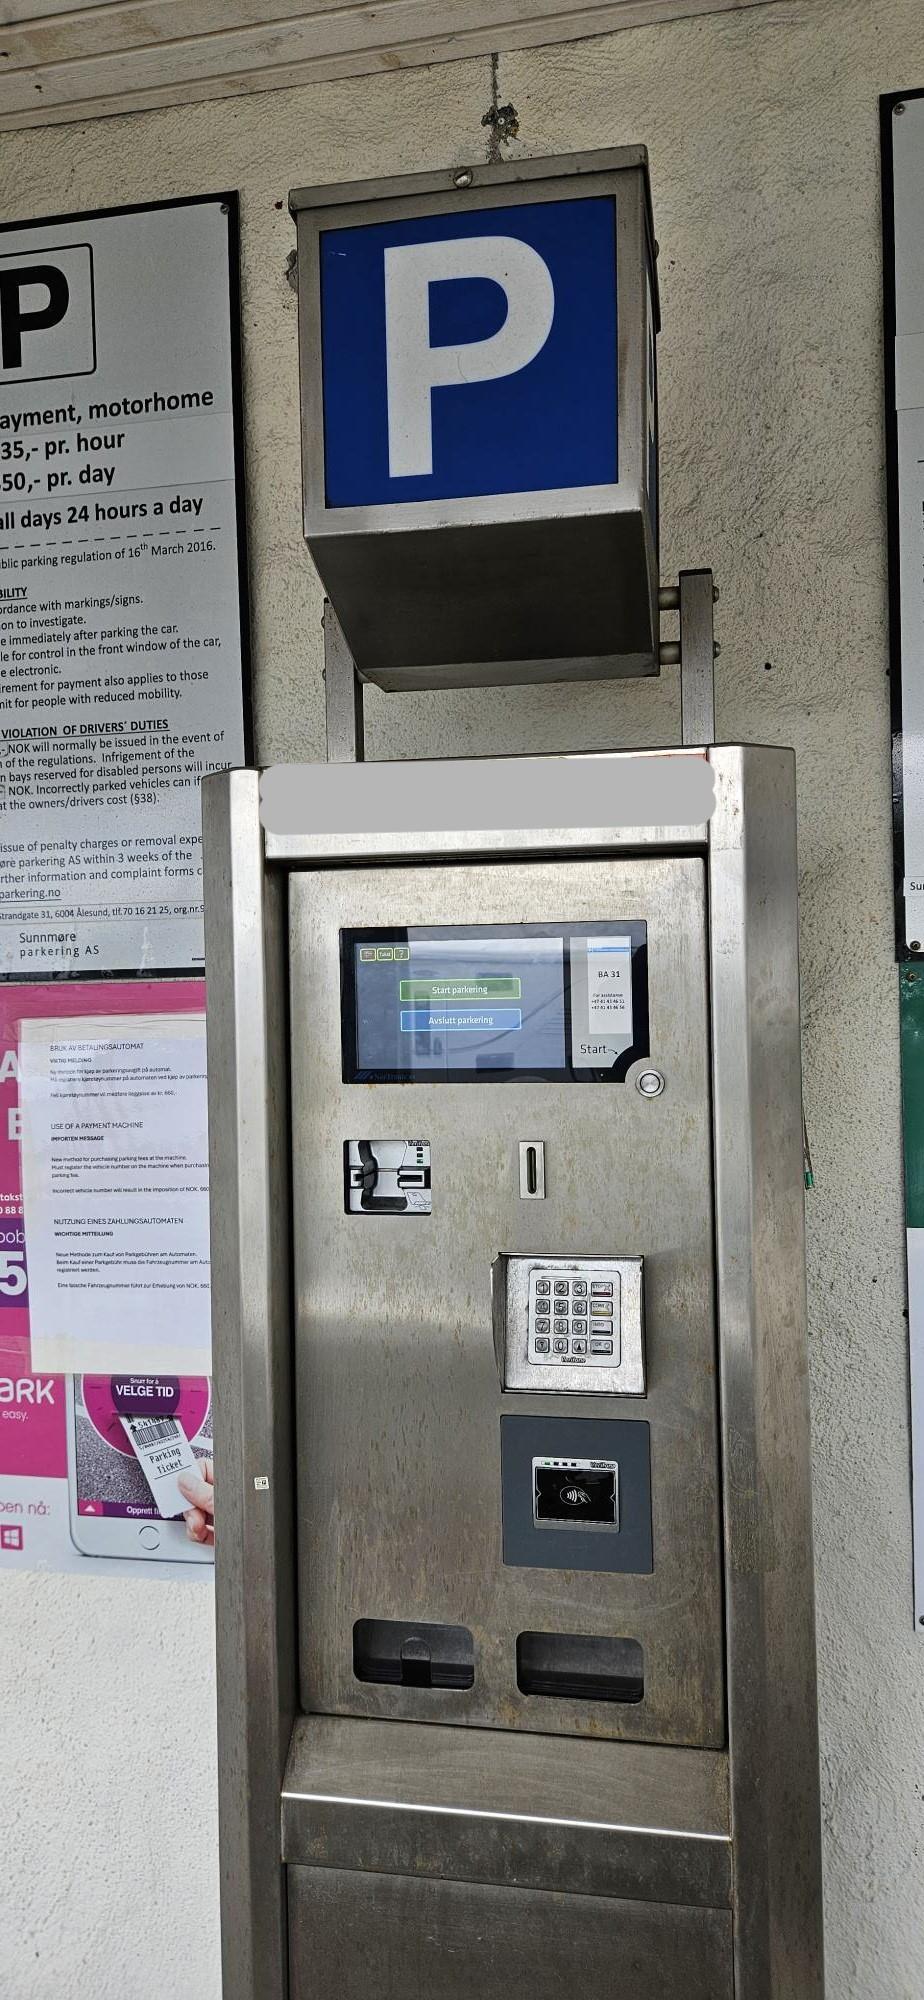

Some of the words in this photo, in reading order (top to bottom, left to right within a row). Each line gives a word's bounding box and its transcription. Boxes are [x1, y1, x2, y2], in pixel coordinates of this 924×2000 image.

[0, 265, 69, 369] P
[384, 235, 554, 478] P
[89, 390, 213, 419] motorhome
[45, 439, 69, 460] pr.
[77, 432, 125, 451] hour
[0, 472, 40, 492] 50,-
[48, 471, 72, 492] pr.
[79, 464, 115, 485] day
[21, 510, 61, 529] days
[68, 506, 89, 524] 24
[95, 503, 147, 520] hours
[154, 502, 163, 515] a
[170, 495, 203, 515] day
[22, 554, 58, 570] parking
[61, 551, 112, 566] regulation
[152, 544, 183, 556] March
[187, 541, 215, 552] 2016.
[40, 600, 62, 611] with
[65, 595, 143, 610] markings/signs.
[2, 621, 14, 630] on
[30, 615, 86, 628] investigate.
[10, 631, 70, 646] immediately
[74, 630, 97, 641] after
[101, 627, 138, 643] parking
[142, 625, 158, 635] the
[161, 625, 178, 633] car.
[12, 650, 26, 661] for
[29, 648, 64, 660] control
[79, 645, 96, 656] the
[98, 642, 123, 655] front
[127, 641, 166, 652] window
[183, 637, 200, 648] the
[204, 637, 221, 648] car,
[10, 665, 61, 676] electronic.
[41, 680, 54, 690] for
[58, 678, 101, 695] payment
[104, 675, 124, 687] also
[128, 673, 163, 690] applies
[180, 670, 208, 680] those
[15, 698, 28, 708] for
[32, 695, 65, 710] people
[69, 693, 91, 704] with
[94, 691, 135, 703] reduced
[138, 688, 182, 700] mobility.
[2, 726, 57, 739] VIOLATION
[63, 725, 77, 735] OF
[130, 719, 168, 731] DUTIES
[8, 743, 30, 754] NOK
[32, 741, 49, 752] will
[53, 739, 96, 751] normally
[115, 736, 146, 747] issued
[162, 734, 179, 745] the
[182, 733, 210, 743] event
[19, 757, 34, 767] the
[38, 754, 96, 767] regulations.
[103, 750, 161, 762] Infrigement
[178, 749, 194, 758] the
[9, 772, 31, 783] bays
[34, 769, 76, 780] reserved
[80, 767, 94, 778] for
[97, 764, 138, 777] disabled
[142, 763, 181, 776] persons
[185, 762, 202, 771] will
[9, 785, 33, 795] NOK.
[37, 782, 89, 794] Incorrectly
[93, 779, 127, 792] parked
[130, 778, 170, 788] vehicles
[173, 779, 190, 787] can
[10, 799, 25, 809] the
[29, 793, 104, 808] owners/drivers
[107, 794, 127, 804] cost
[41, 840, 77, 853] penalty
[80, 838, 118, 850] charges
[135, 835, 176, 846] removal
[19, 855, 65, 869] parkering
[69, 855, 80, 864] AS
[84, 854, 114, 864] within
[118, 854, 124, 862] 3
[127, 852, 158, 862] weeks
[175, 850, 192, 860] the
[28, 871, 86, 882] information
[89, 870, 107, 880] and
[111, 868, 161, 880] complaint
[165, 867, 193, 876] forms
[41, 910, 52, 919] 31,
[55, 910, 74, 918] 6004
[76, 907, 110, 918] Ålesund,
[135, 907, 145, 915] 16
[147, 906, 157, 914] 21
[159, 906, 172, 915] 25,
[20, 932, 76, 943] Sunnmøre
[20, 947, 79, 958] parkering
[85, 945, 99, 955] AS
[598, 970, 609, 978] BA
[611, 970, 620, 978] 31
[432, 985, 450, 994] Start
[452, 985, 488, 996] parkering
[428, 1015, 456, 1025] Avslutt
[458, 1015, 493, 1026] parkering
[580, 1043, 607, 1054] Start
[0, 1250, 27, 1296] 5
[116, 1384, 153, 1397] VELGE
[158, 1385, 174, 1398] TID
[3, 1411, 28, 1421] easy.
[150, 1447, 181, 1463] Parking
[157, 1459, 183, 1474] Ticket
